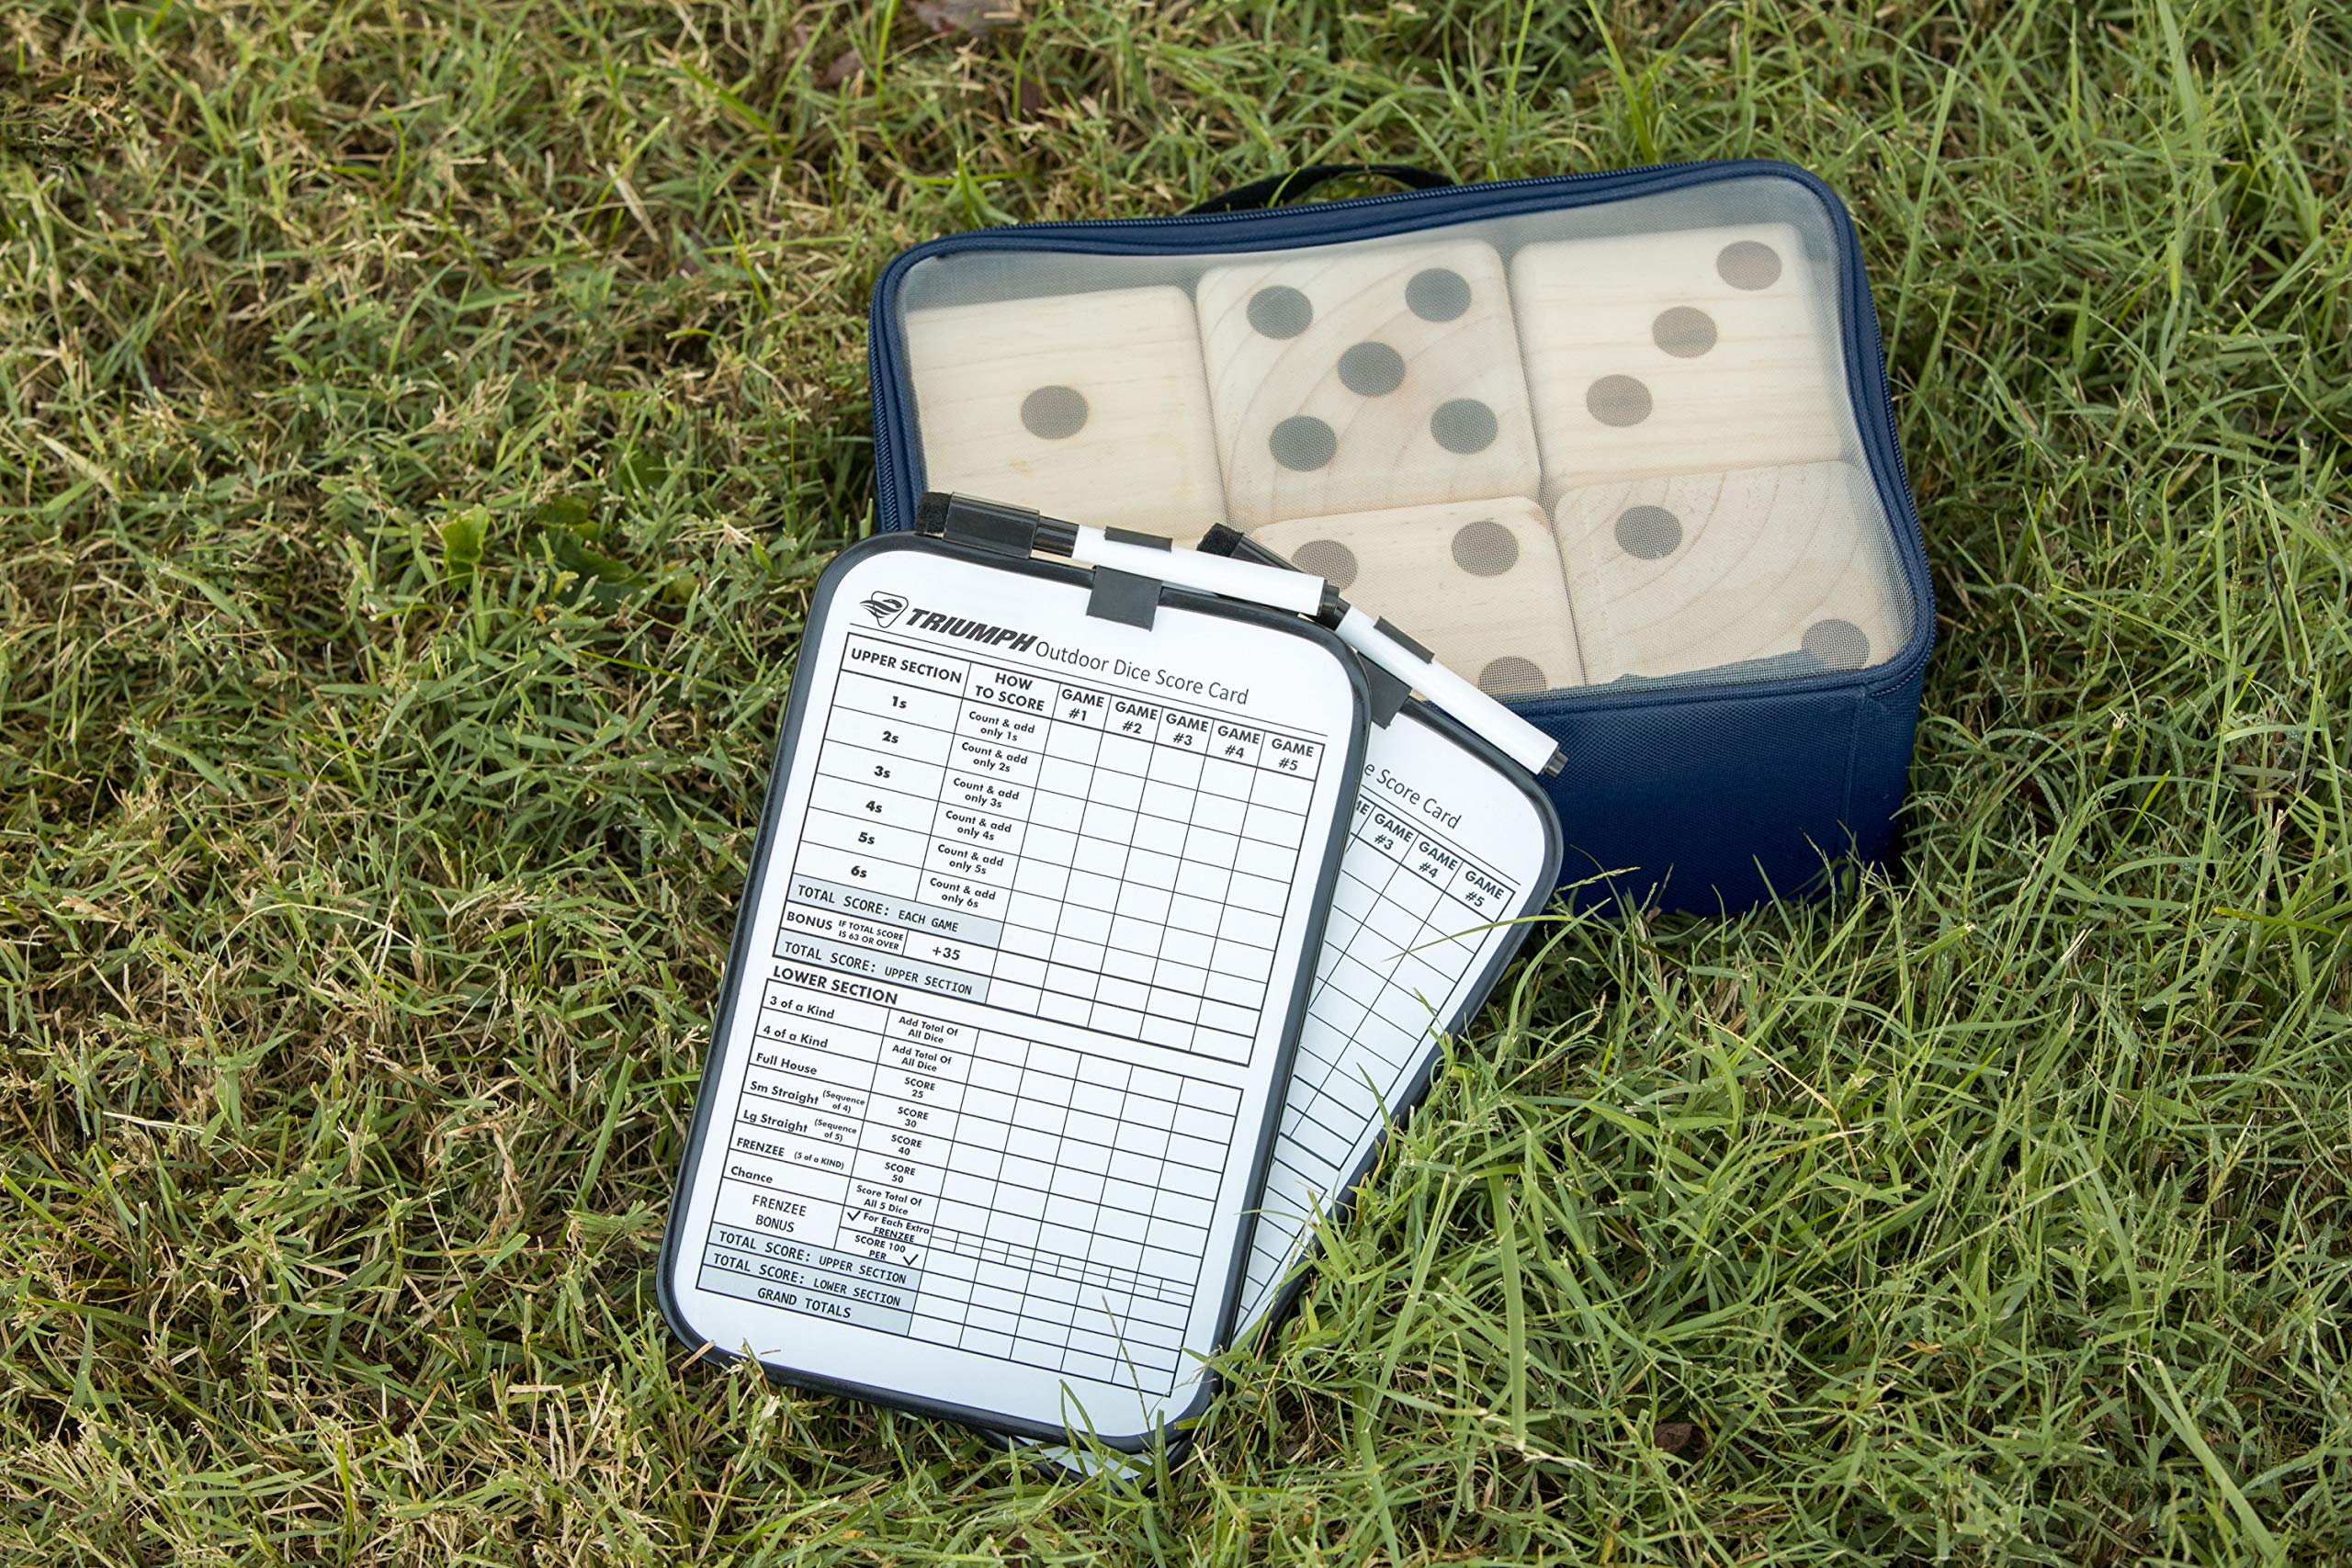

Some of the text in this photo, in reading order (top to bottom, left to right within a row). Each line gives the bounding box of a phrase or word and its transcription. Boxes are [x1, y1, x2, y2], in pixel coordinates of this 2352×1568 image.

[852, 648, 962, 683] UPPER SECTION
[906, 608, 1249, 705] TRIUMPH Outdoor Dice Score Card
[995, 672, 1033, 690] HOW
[893, 695, 907, 709] 1s
[976, 685, 1045, 711] TO SCORE
[1061, 689, 1104, 707] GAME
[1069, 708, 1087, 721] #1
[1115, 701, 1158, 720] GAME
[969, 711, 1035, 733] Count & add
[1122, 720, 1142, 734] #2
[1166, 713, 1209, 732] GAME
[882, 730, 899, 744] 2s
[980, 728, 1017, 741] only 1s
[1173, 732, 1193, 746] #3
[1217, 726, 1261, 745] GAME
[962, 742, 1028, 764] Count & add
[1225, 745, 1244, 758] #4
[1272, 739, 1314, 757] GAME
[874, 765, 890, 778] 3s
[973, 759, 1010, 773] only 2s
[1279, 758, 1298, 771] #5
[954, 777, 1020, 800] Count & add
[865, 800, 882, 813] 4s
[965, 794, 1002, 807] only 3s
[1376, 769, 1420, 805] Score
[1423, 798, 1462, 829] Card
[945, 810, 1012, 833] Count & add
[1374, 813, 1414, 844] GAME
[858, 831, 875, 845] 5s
[957, 827, 994, 840] only 4s
[1374, 834, 1394, 850] #3
[938, 844, 1004, 866] Count & add
[1419, 841, 1458, 872] GAME
[851, 865, 867, 878] 6s
[949, 861, 986, 874] only 5s
[1419, 863, 1438, 878] #4
[930, 877, 996, 900] Count & add
[1465, 871, 1504, 901] GAME
[941, 894, 978, 908] only 6s
[1465, 891, 1485, 907] #5
[798, 885, 959, 932] TOTAL SCORE: EACH GAME
[786, 911, 832, 931] BONUS
[849, 922, 874, 934] TOTAL
[876, 929, 903, 941] SCORE
[862, 936, 874, 944] OR
[876, 939, 899, 950] OVER
[933, 947, 960, 961] +35
[785, 941, 972, 995] TOTAL SCORE: UPPER SECTION
[774, 965, 898, 1005] LOWER SECTION
[770, 996, 777, 1006] 3
[781, 999, 794, 1009] of
[807, 1004, 835, 1019] Kind
[899, 1016, 958, 1036] Add Total Of
[763, 1025, 771, 1034] 4
[774, 1029, 786, 1038] of
[800, 1033, 828, 1048] Kind
[908, 1029, 944, 1043] All Dice
[892, 1044, 952, 1065] Add Total Of
[756, 1053, 817, 1075] Full House
[901, 1057, 937, 1072] All Dice
[750, 1081, 819, 1105] Sm Straight
[904, 1077, 935, 1091] SCORE
[822, 1089, 865, 1105] (Sequence
[911, 1089, 923, 1099] 25
[842, 1105, 851, 1113] 4)
[898, 1106, 929, 1121] SCORE
[743, 1109, 808, 1133] Lg Straight
[814, 1119, 857, 1134] (Sequence
[905, 1119, 917, 1128] 30
[737, 1137, 785, 1156] FRENZEE
[834, 1134, 842, 1143] 5)
[891, 1134, 922, 1148] SCORE
[899, 1146, 910, 1156] 40
[794, 1151, 802, 1159] (5
[820, 1157, 844, 1170] KIND)
[885, 1162, 916, 1176] SCORE
[730, 1166, 773, 1183] Chance
[891, 1174, 904, 1183] 50
[856, 1185, 922, 1206] Score Total Of
[752, 1194, 807, 1217] FRENZEE
[864, 1199, 909, 1215] All 5 Dice
[755, 1214, 795, 1233] BONUS
[864, 1213, 930, 1235] For Each Extra
[854, 1235, 906, 1253] SCORE 100
[873, 1226, 916, 1244] FRENZEE
[719, 1231, 907, 1284] TOTAL SCORE: UPPER SECTION
[869, 1249, 887, 1260] PER
[714, 1253, 900, 1306] TOTAL SCORE: LOWER SECTION
[757, 1287, 852, 1318] GRAND TOTALS
